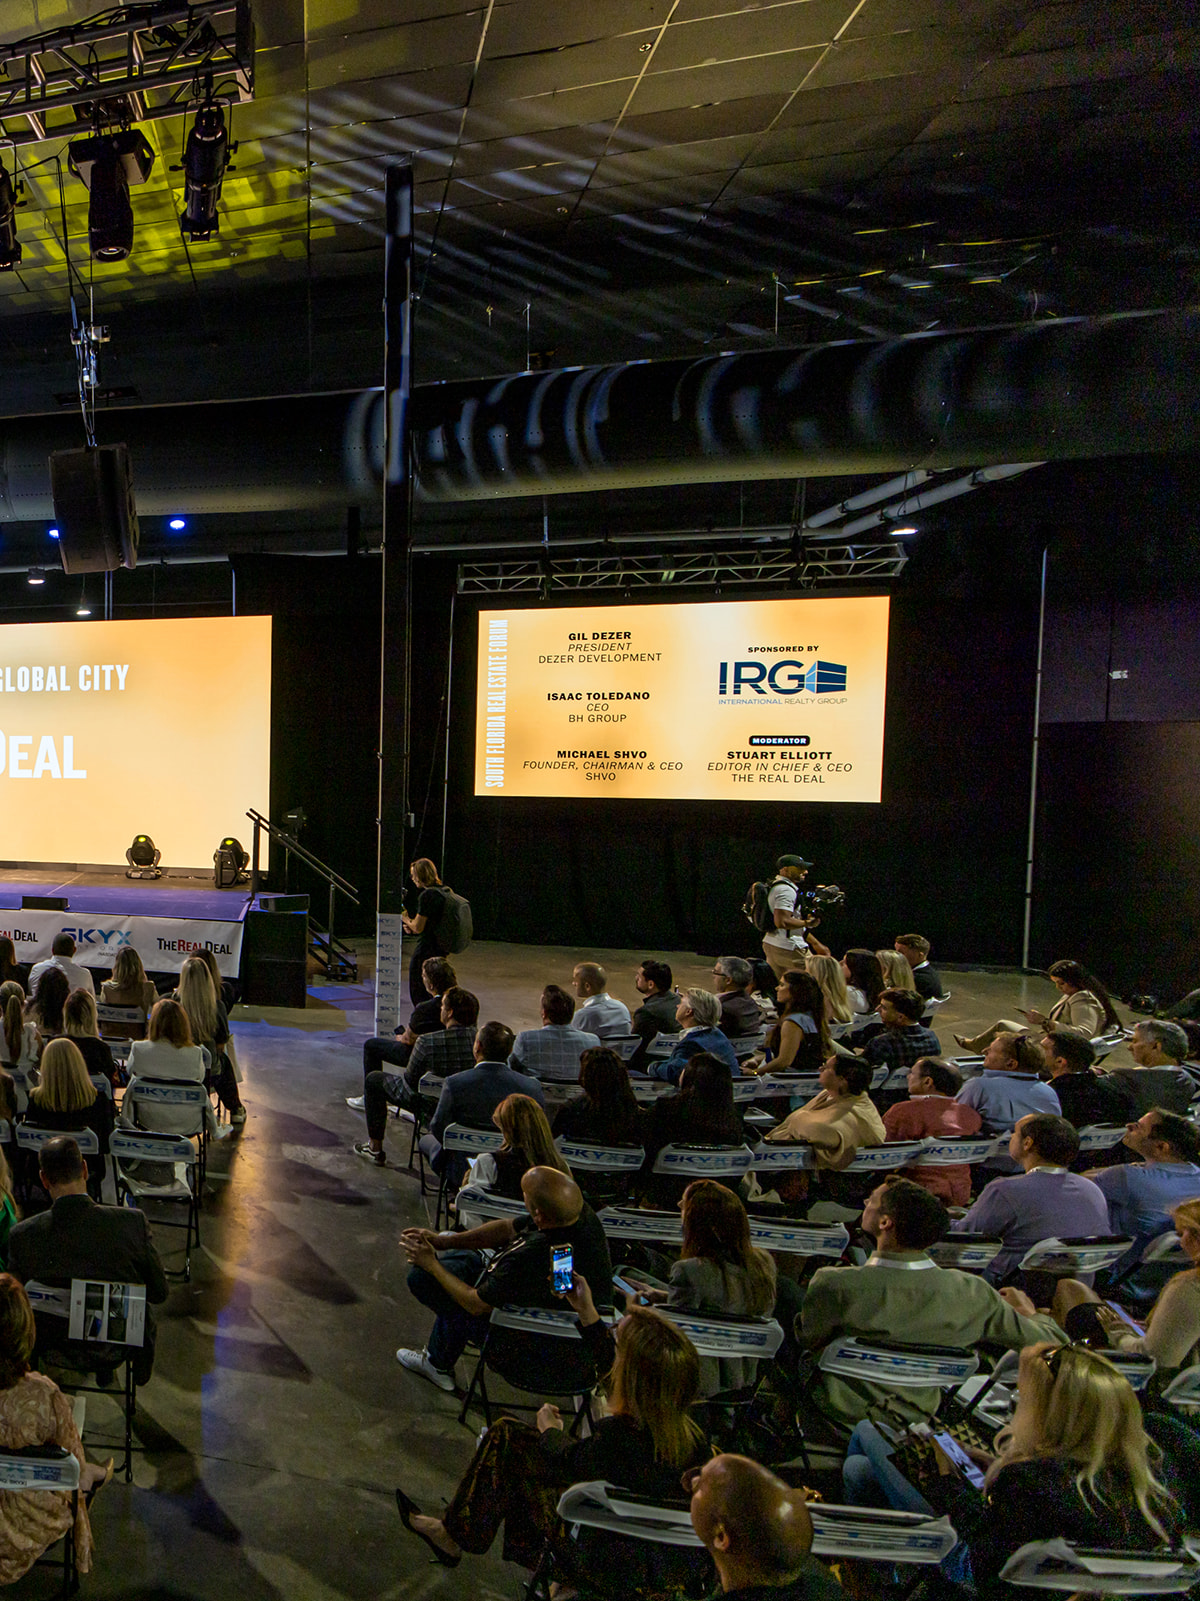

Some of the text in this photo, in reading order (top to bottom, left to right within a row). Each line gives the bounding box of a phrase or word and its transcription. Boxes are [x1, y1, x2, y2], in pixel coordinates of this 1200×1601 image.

[568, 631, 632, 641] GIL DEZER
[567, 642, 632, 652] PRESIDENT
[538, 652, 662, 664] DEZER DEVELOPMENT
[78, 664, 129, 691] CITY
[719, 660, 805, 695] IRG
[547, 691, 650, 701] ISAAC TOLEDANO
[485, 619, 508, 787] SOUTH FLORIDA REAL ESTATE FORUM
[586, 703, 609, 711] CEO
[568, 714, 627, 723] BH GROUP
[557, 750, 647, 759] MICHAEL SHVO
[727, 751, 832, 760] STUART ELLIOTT
[522, 760, 683, 771] FOUNDER, CHAIRMAN & CEO
[707, 762, 853, 772] EDITOR IN CHIEF & CEO
[585, 772, 616, 781] SHVO
[731, 773, 825, 783] THE REAL DEAL
[61, 927, 132, 946] SKYX
[420, 1079, 442, 1088] SK
[134, 1086, 181, 1098] SKYX
[18, 1132, 46, 1140] SK
[560, 1147, 618, 1161] SKYX
[664, 1154, 726, 1165] SKYX
[28, 1291, 63, 1302] SK
